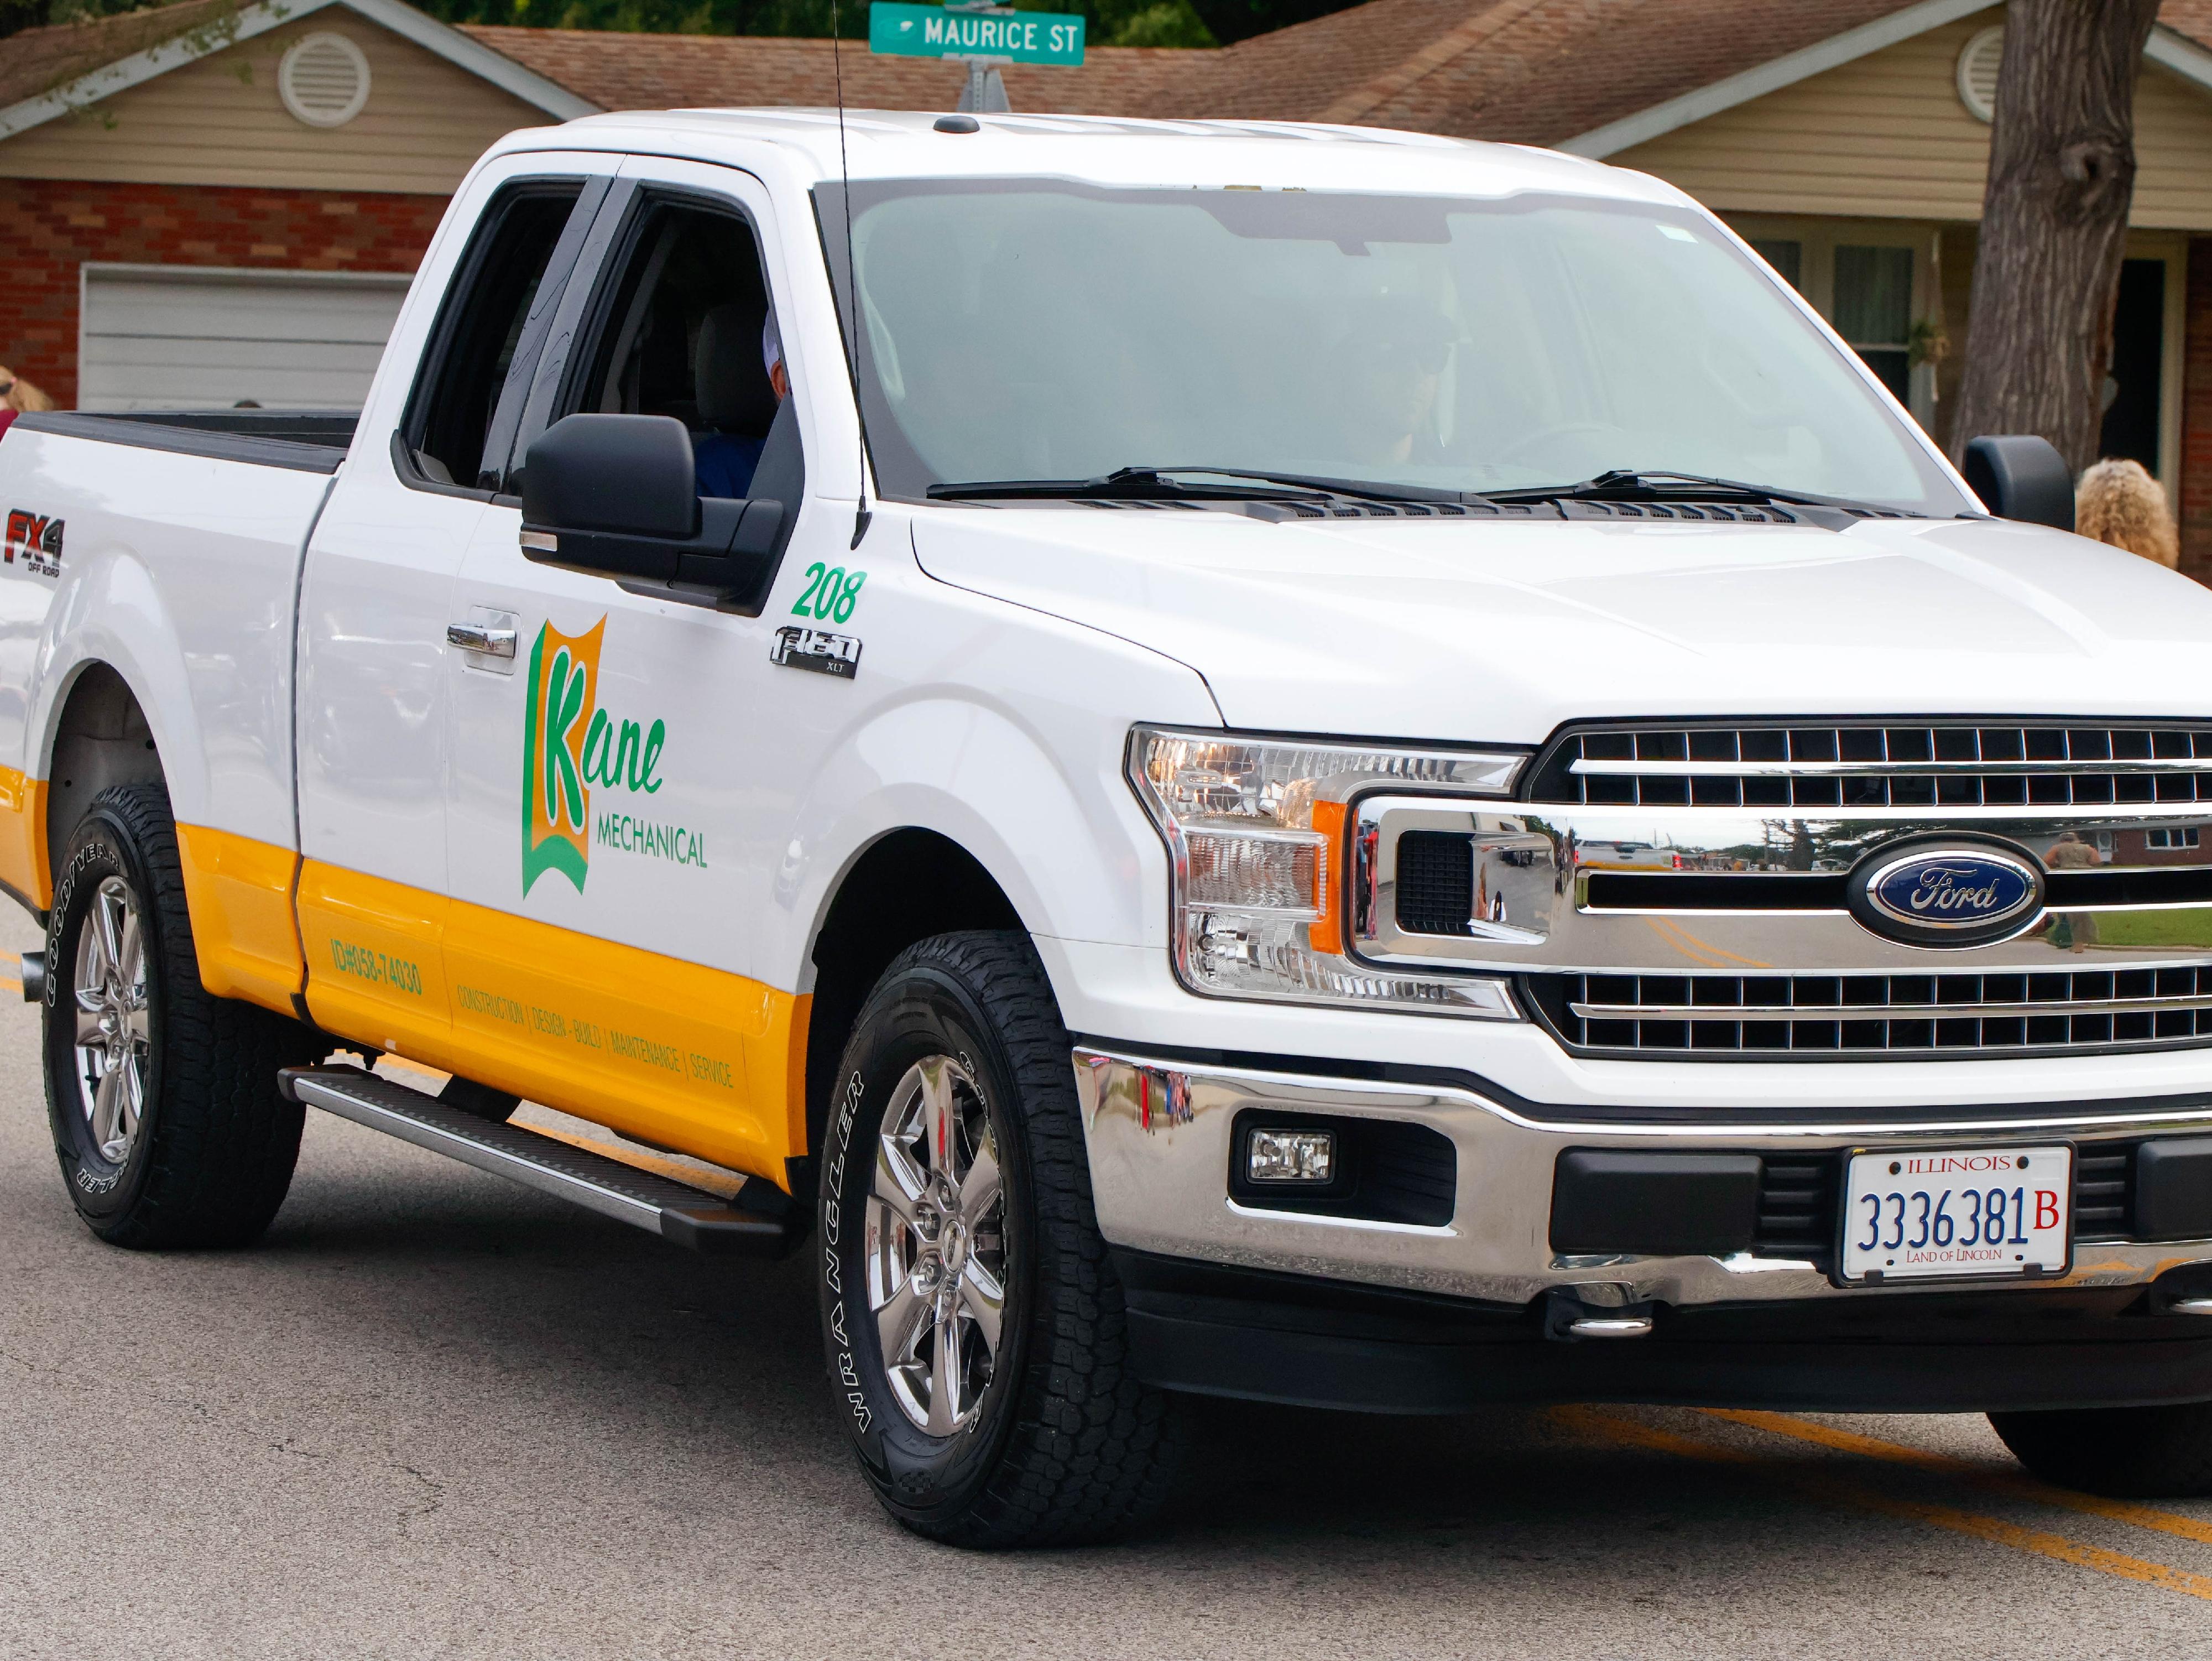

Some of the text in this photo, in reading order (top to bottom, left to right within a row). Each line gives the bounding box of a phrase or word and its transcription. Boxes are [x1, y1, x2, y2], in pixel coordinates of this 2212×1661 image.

[925, 17, 1078, 53] MAURICE ST
[4, 508, 65, 567] FX4
[28, 562, 59, 578] OFF ROAD
[791, 562, 868, 624] 208
[826, 662, 845, 673] XLT
[546, 651, 665, 828] Kane
[597, 810, 707, 868] MECHANICAL
[1911, 868, 2000, 909] Ford
[457, 985, 734, 1089] CONSTRUCTION DESIGN BUILD MAINTENANCE SERVICE
[1908, 1156, 2010, 1174] ILLINOIS
[1858, 1187, 2059, 1251] 3336381 B
[826, 1070, 872, 1434] WRANGLER
[1940, 1250, 1953, 1262] OF
